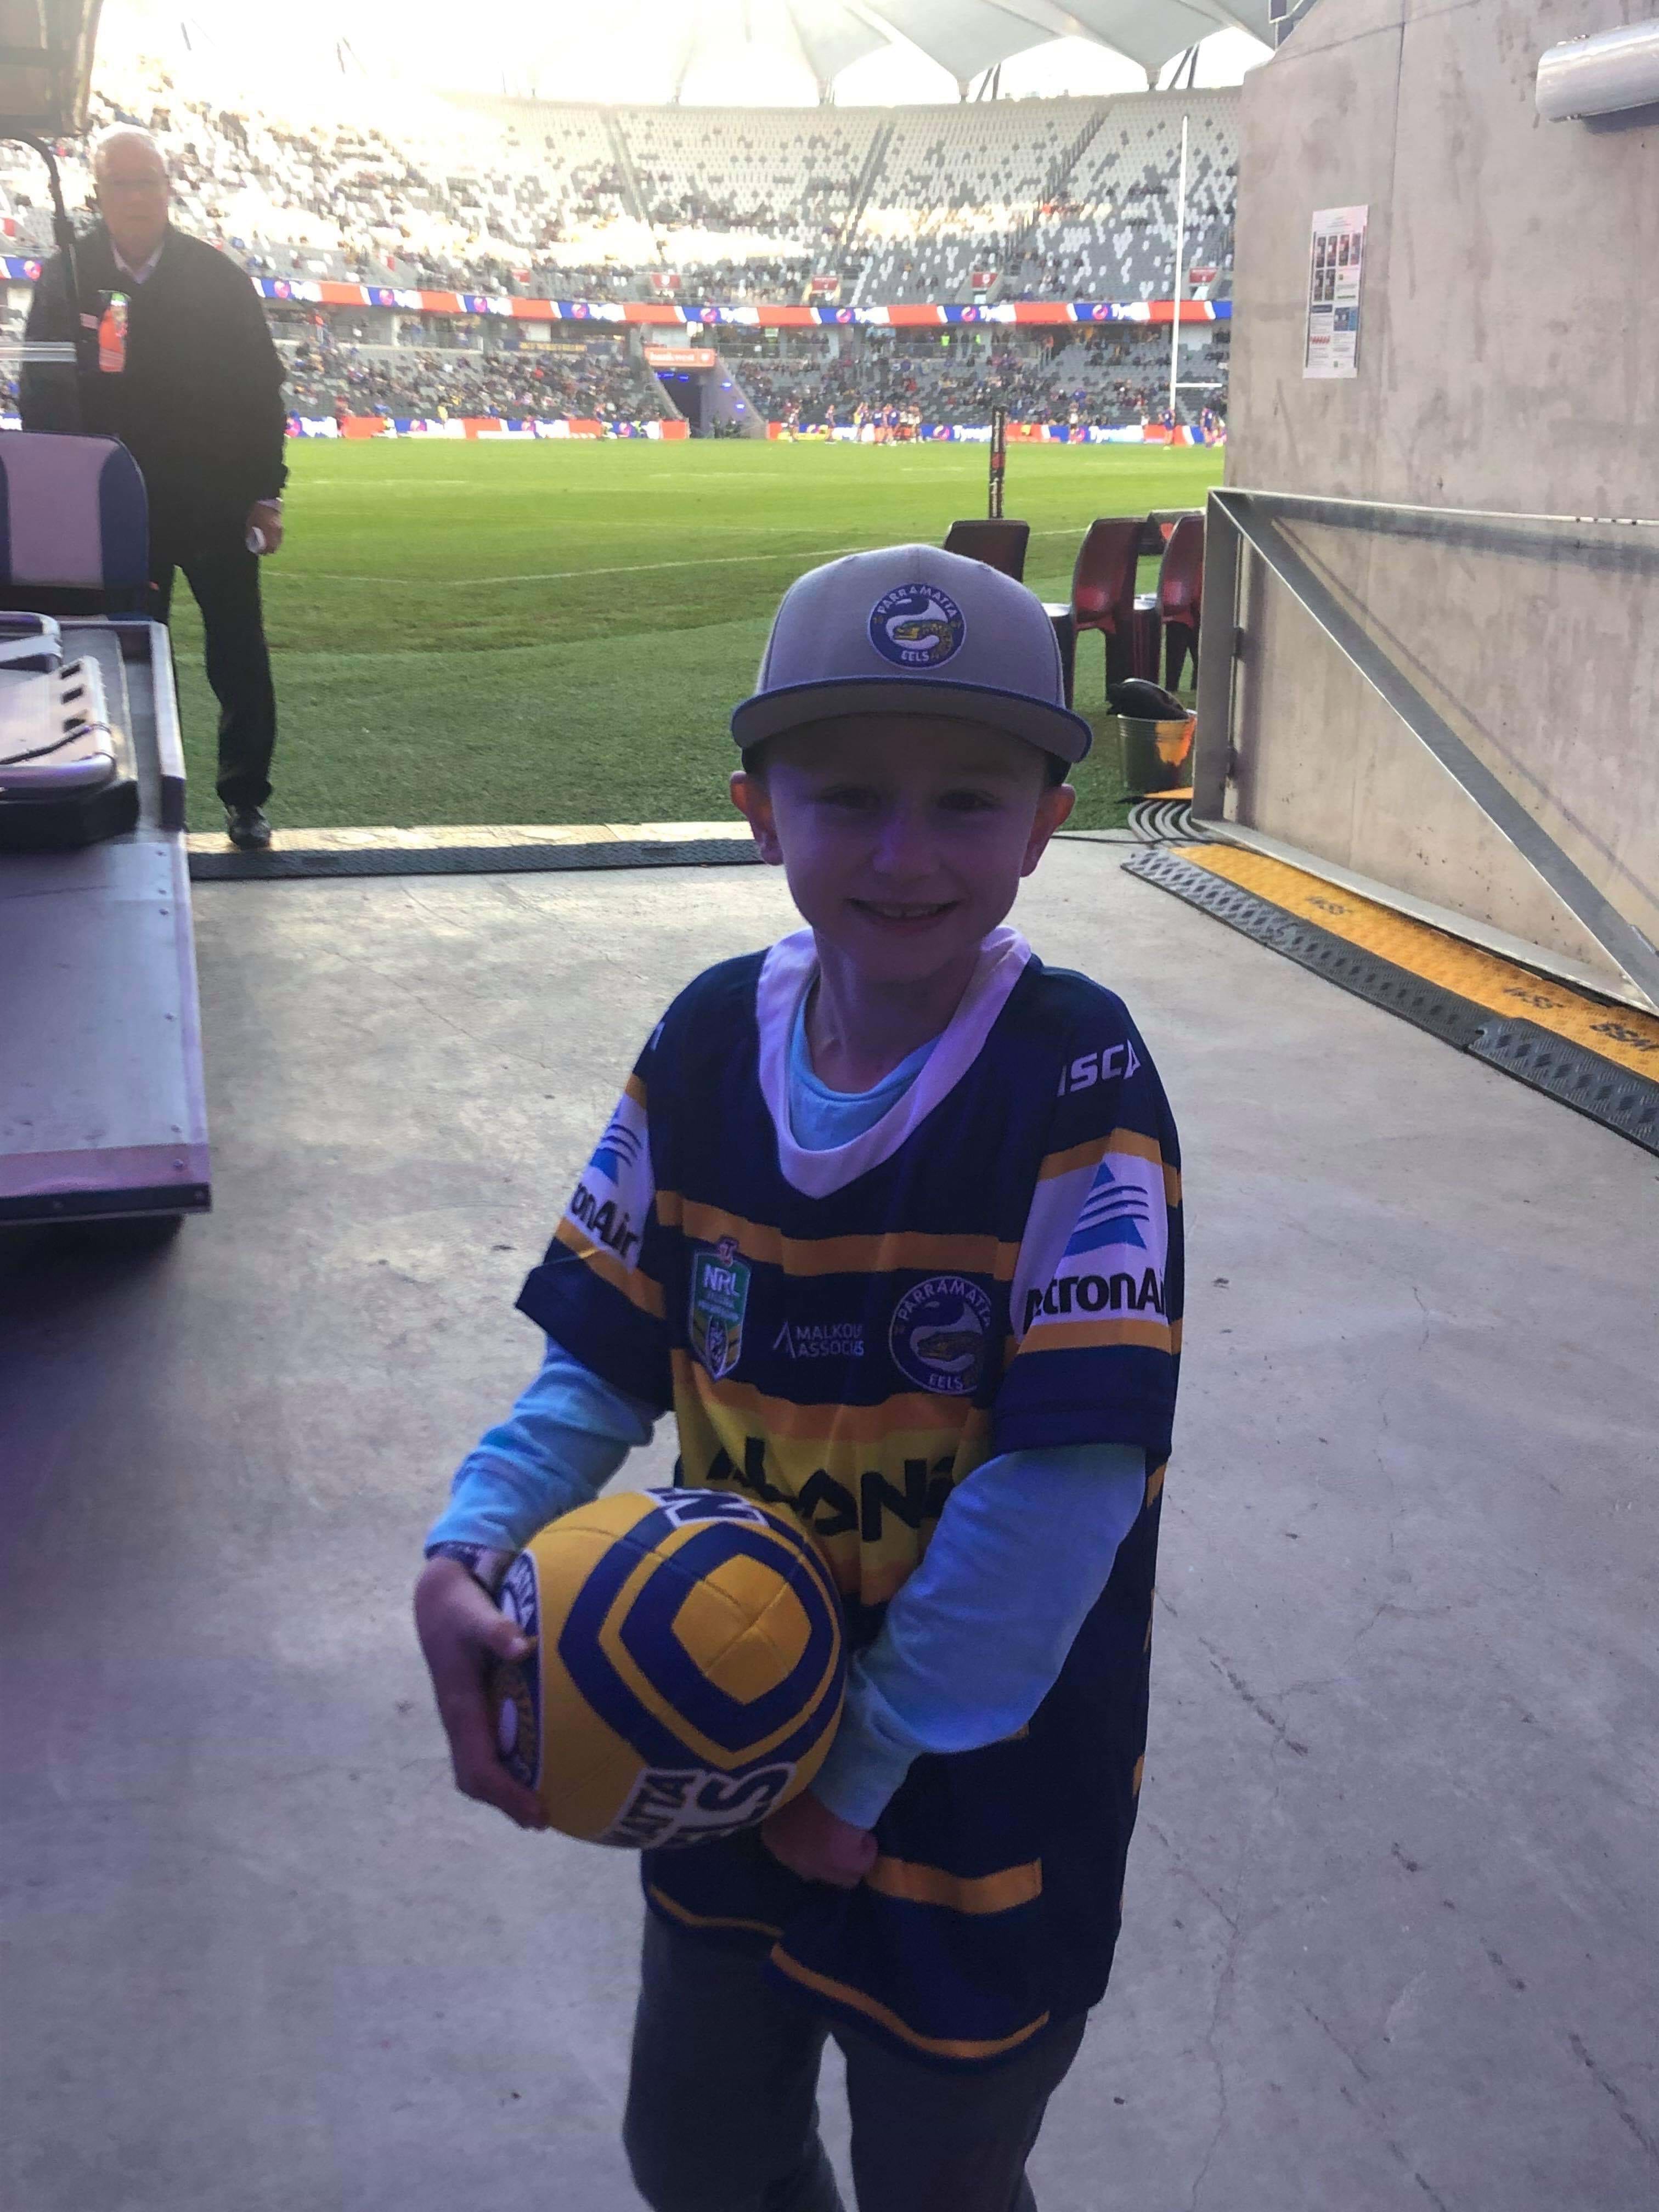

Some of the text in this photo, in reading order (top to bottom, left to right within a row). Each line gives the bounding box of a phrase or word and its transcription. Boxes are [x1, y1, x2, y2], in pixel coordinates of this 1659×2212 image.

[877, 585, 958, 617] PARRAMATTA
[901, 650, 930, 662] EELS
[703, 1263, 740, 1296] NRL
[929, 1373, 964, 1390] EELS
